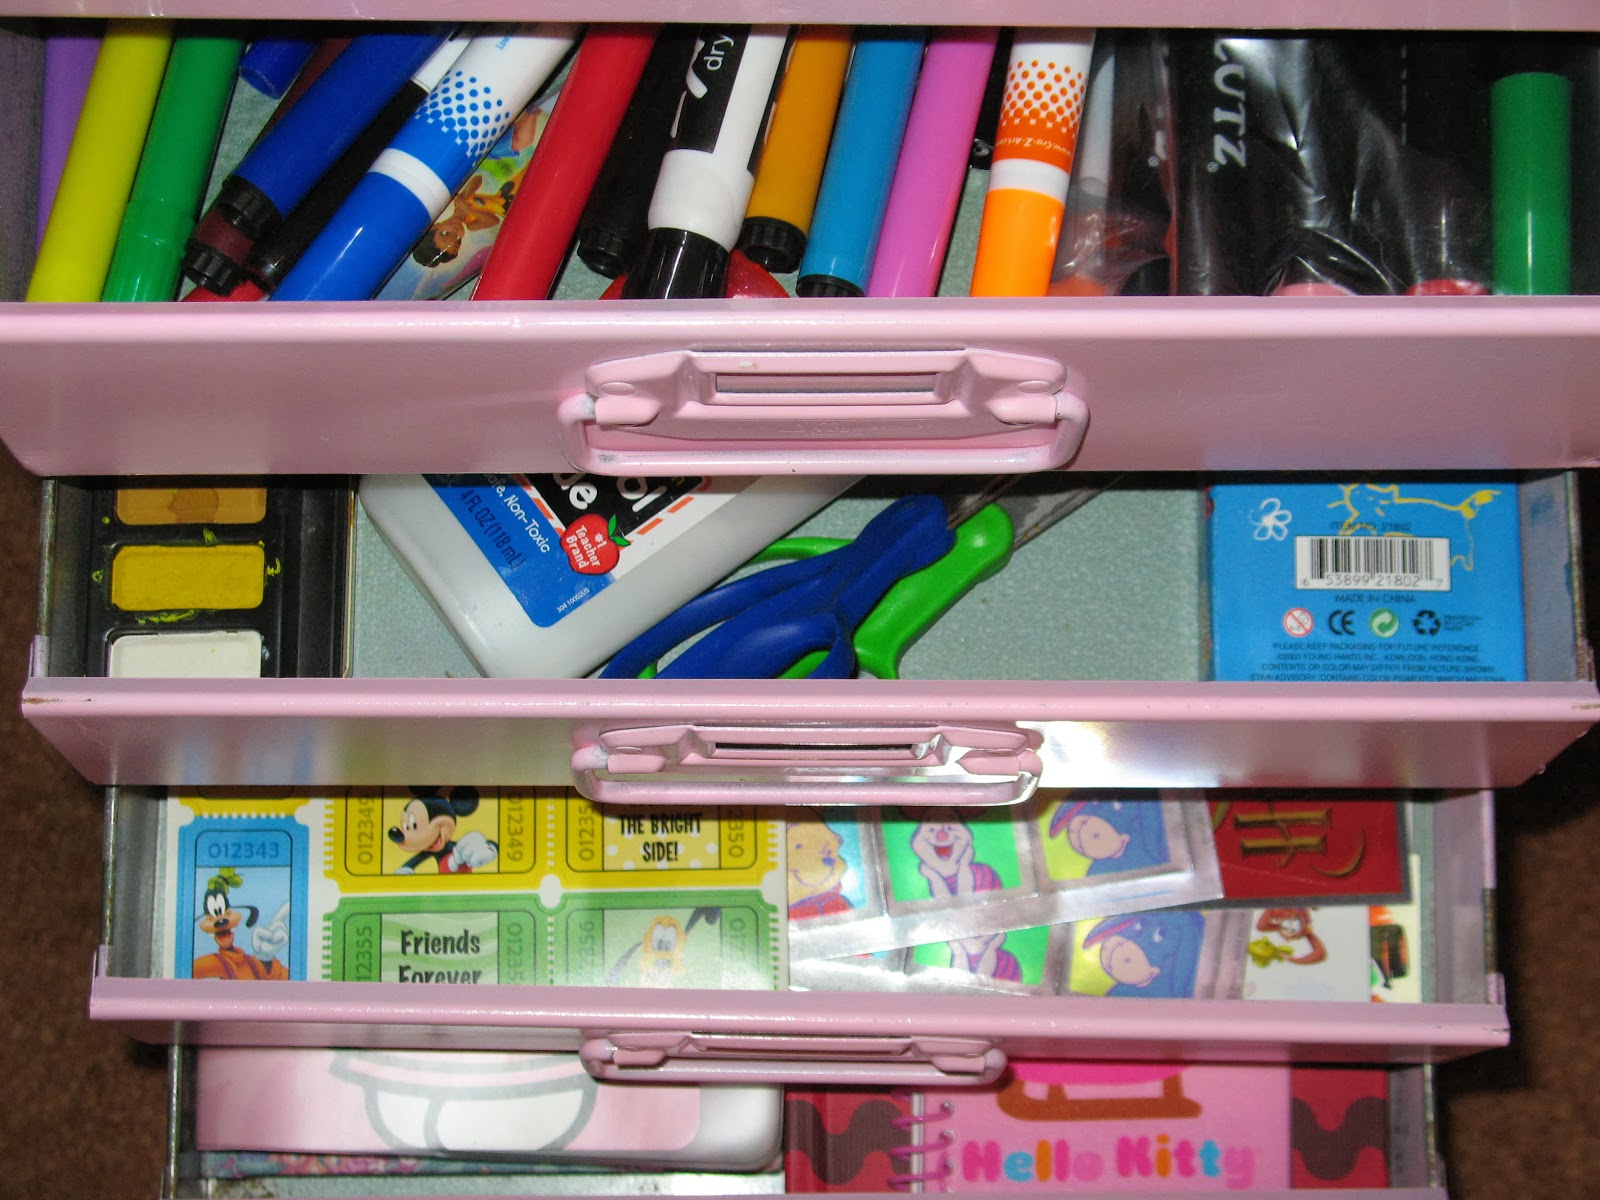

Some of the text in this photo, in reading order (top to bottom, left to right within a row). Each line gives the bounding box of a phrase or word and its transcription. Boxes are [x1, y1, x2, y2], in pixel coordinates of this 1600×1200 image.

[703, 33, 734, 71] dry
[503, 494, 551, 554] Non-Toxic
[575, 525, 601, 567] Teacher
[594, 532, 608, 548] #1
[566, 535, 590, 569] Brand
[1303, 573, 1445, 588] 6 53899 21802 7
[1335, 594, 1416, 603] MADE IN CHINA
[1262, 663, 1306, 671] CONTENTS
[620, 811, 703, 834] THE BRIGHT
[208, 839, 279, 860] 012343
[643, 841, 679, 862] SIDE!
[401, 928, 481, 956] Friends
[962, 1133, 1256, 1190] Hello Kitty
